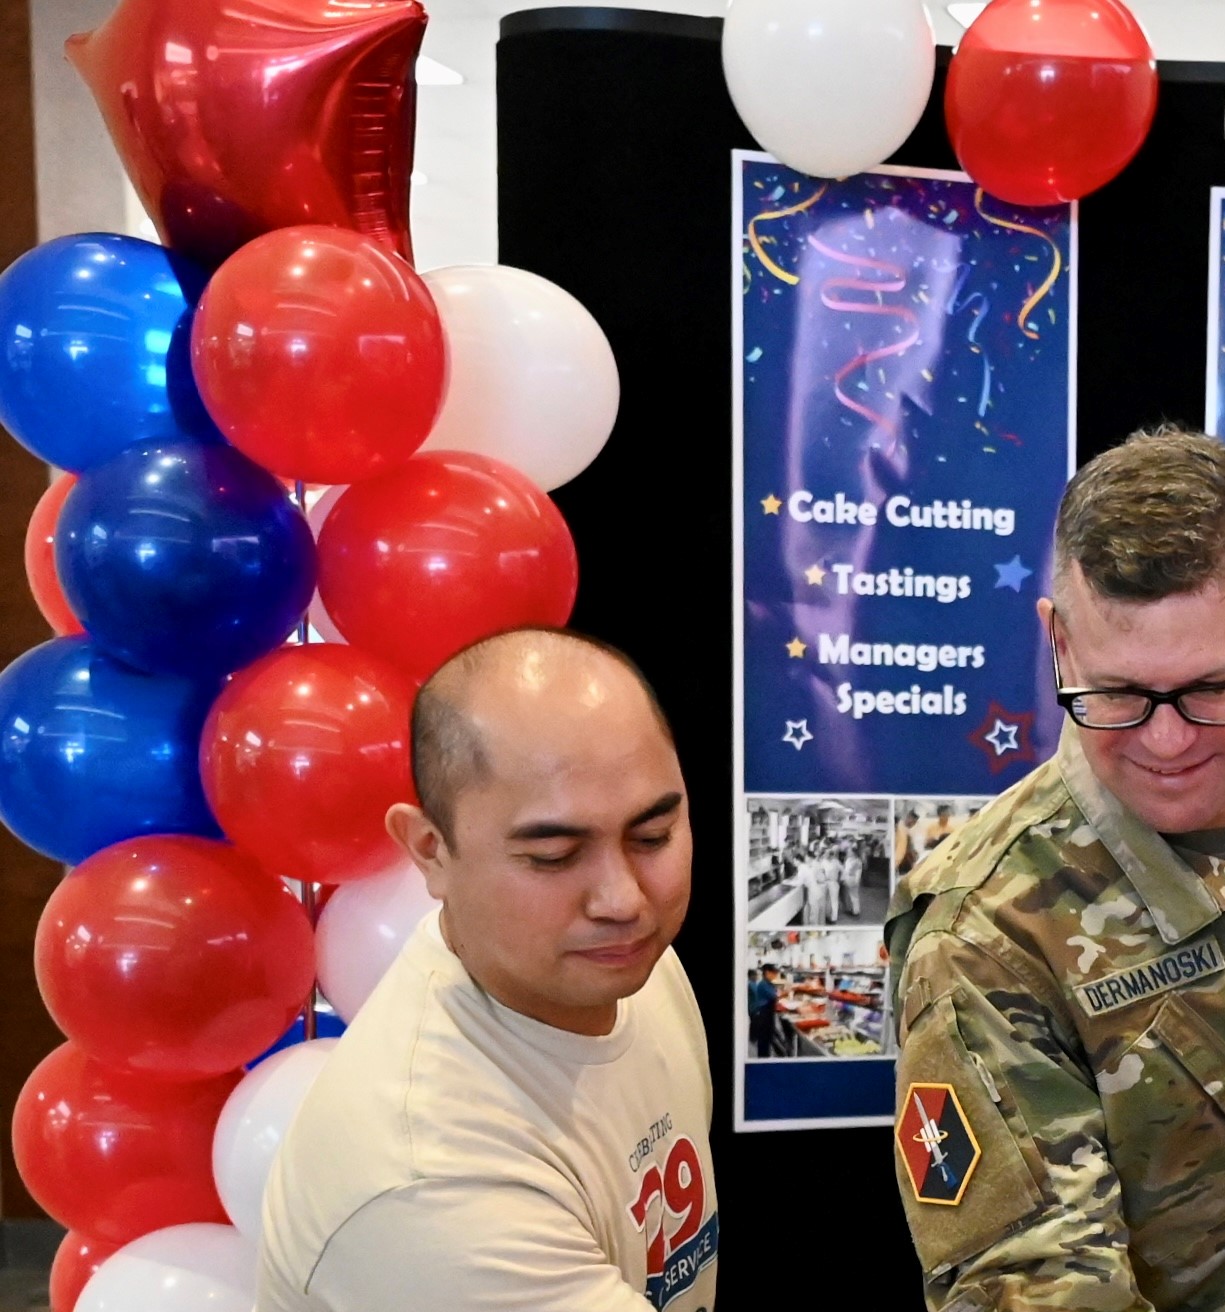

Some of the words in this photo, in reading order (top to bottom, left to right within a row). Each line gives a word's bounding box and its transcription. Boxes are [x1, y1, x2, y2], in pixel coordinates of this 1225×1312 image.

[788, 490, 878, 526] Cake
[886, 495, 1015, 536] Cutting
[832, 564, 971, 603] Tastings
[818, 633, 985, 672] Managers
[836, 682, 967, 719] Specials
[1086, 943, 1221, 1012] DERMANOSKI
[626, 1134, 706, 1279] 29
